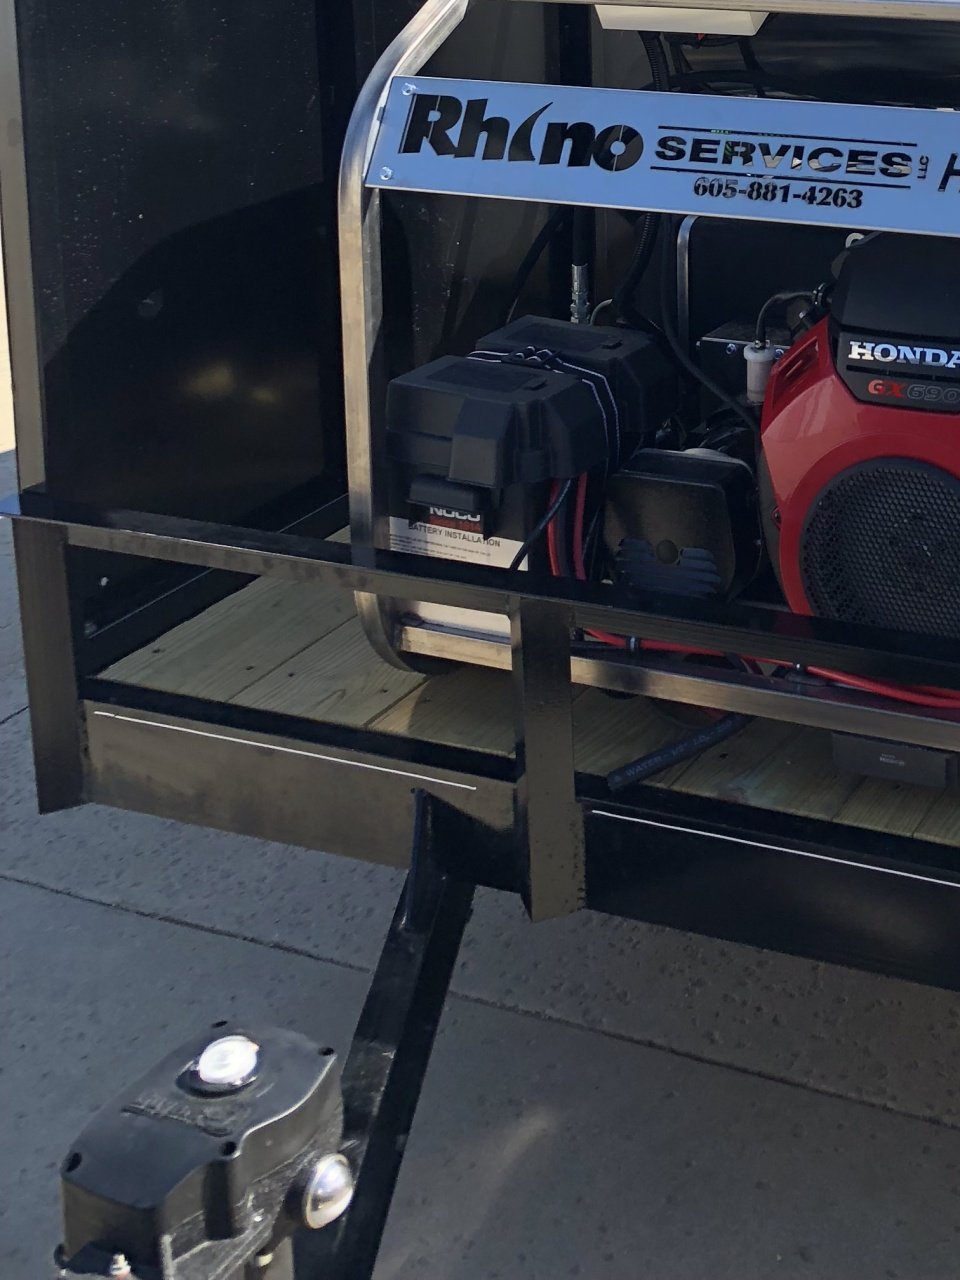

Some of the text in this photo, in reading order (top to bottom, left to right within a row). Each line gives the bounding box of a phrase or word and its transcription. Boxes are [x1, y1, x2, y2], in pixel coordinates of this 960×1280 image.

[398, 93, 644, 171] Rhino
[654, 135, 930, 180] SERVICES LLC
[693, 176, 863, 209] 605-881-4263
